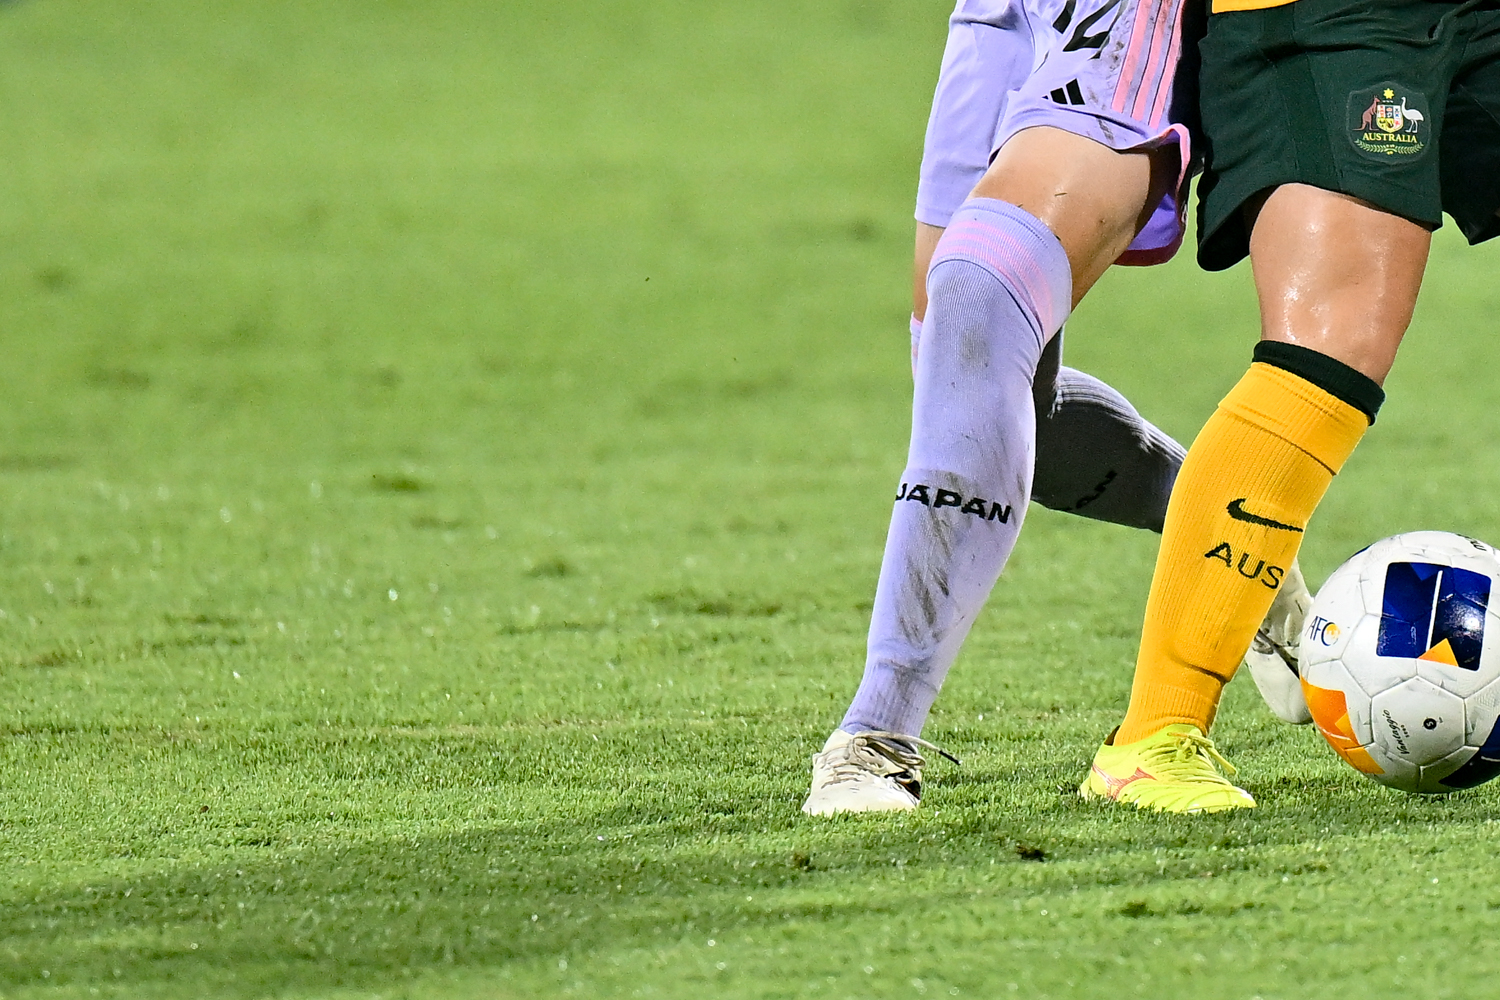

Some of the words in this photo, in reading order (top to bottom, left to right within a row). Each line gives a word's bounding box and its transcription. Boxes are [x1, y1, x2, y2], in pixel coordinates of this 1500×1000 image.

[1362, 132, 1418, 144] AUSTRALIA
[895, 483, 1012, 525] JAPAN
[1204, 542, 1285, 589] AUS
[1304, 615, 1341, 647] AFC
